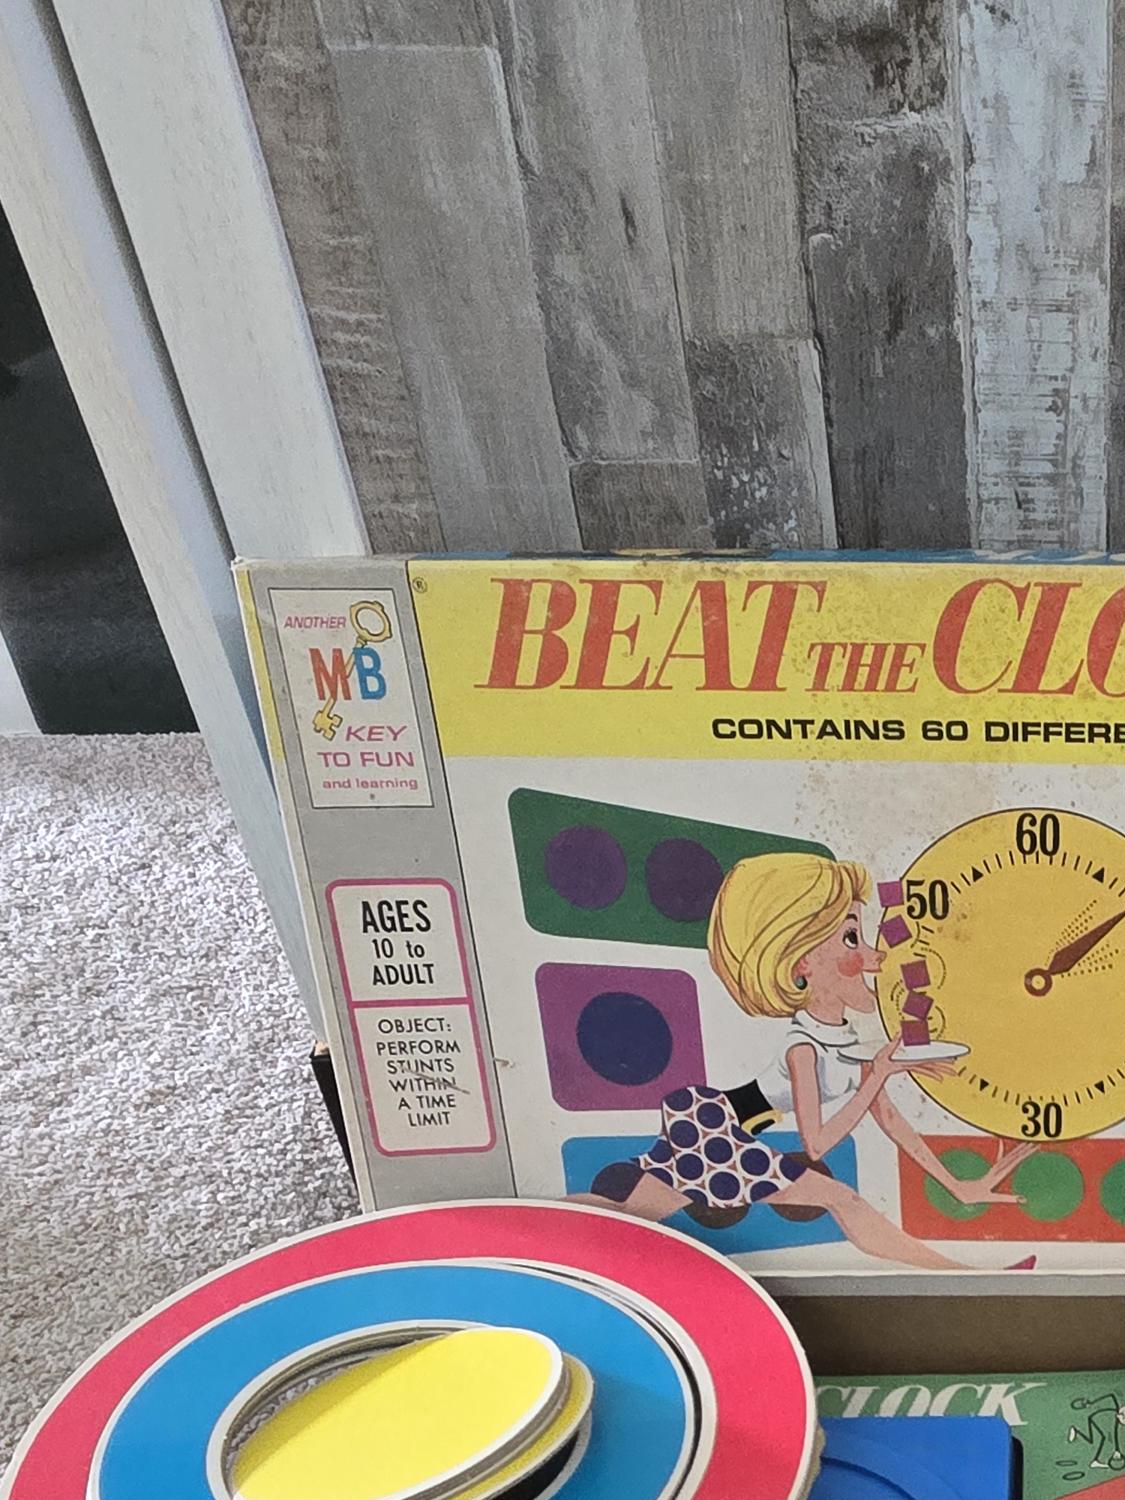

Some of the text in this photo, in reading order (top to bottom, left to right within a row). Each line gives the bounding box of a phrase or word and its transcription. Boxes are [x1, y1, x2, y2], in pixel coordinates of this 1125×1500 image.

[284, 616, 347, 629] ANOTHER
[473, 577, 827, 692] BEAT
[803, 642, 927, 693] THE
[309, 647, 387, 700] MB
[346, 726, 407, 741] KEY
[712, 718, 906, 740] CONTAINS
[921, 720, 968, 741] 60
[317, 752, 414, 767] TO FUN
[322, 778, 418, 790] and learning
[1016, 813, 1060, 856] 60
[906, 880, 949, 920] 50
[361, 900, 431, 934] AGES
[372, 938, 425, 959] 10 to
[372, 964, 434, 986] ADULT
[378, 1018, 451, 1034] OBJECT:
[376, 1040, 461, 1055] PERFORM
[387, 1058, 454, 1074] STUNTS
[389, 1077, 456, 1092] WITHIN
[399, 1094, 456, 1110] A TIME
[408, 1111, 451, 1127] LIMIT
[1021, 1101, 1062, 1138] 30
